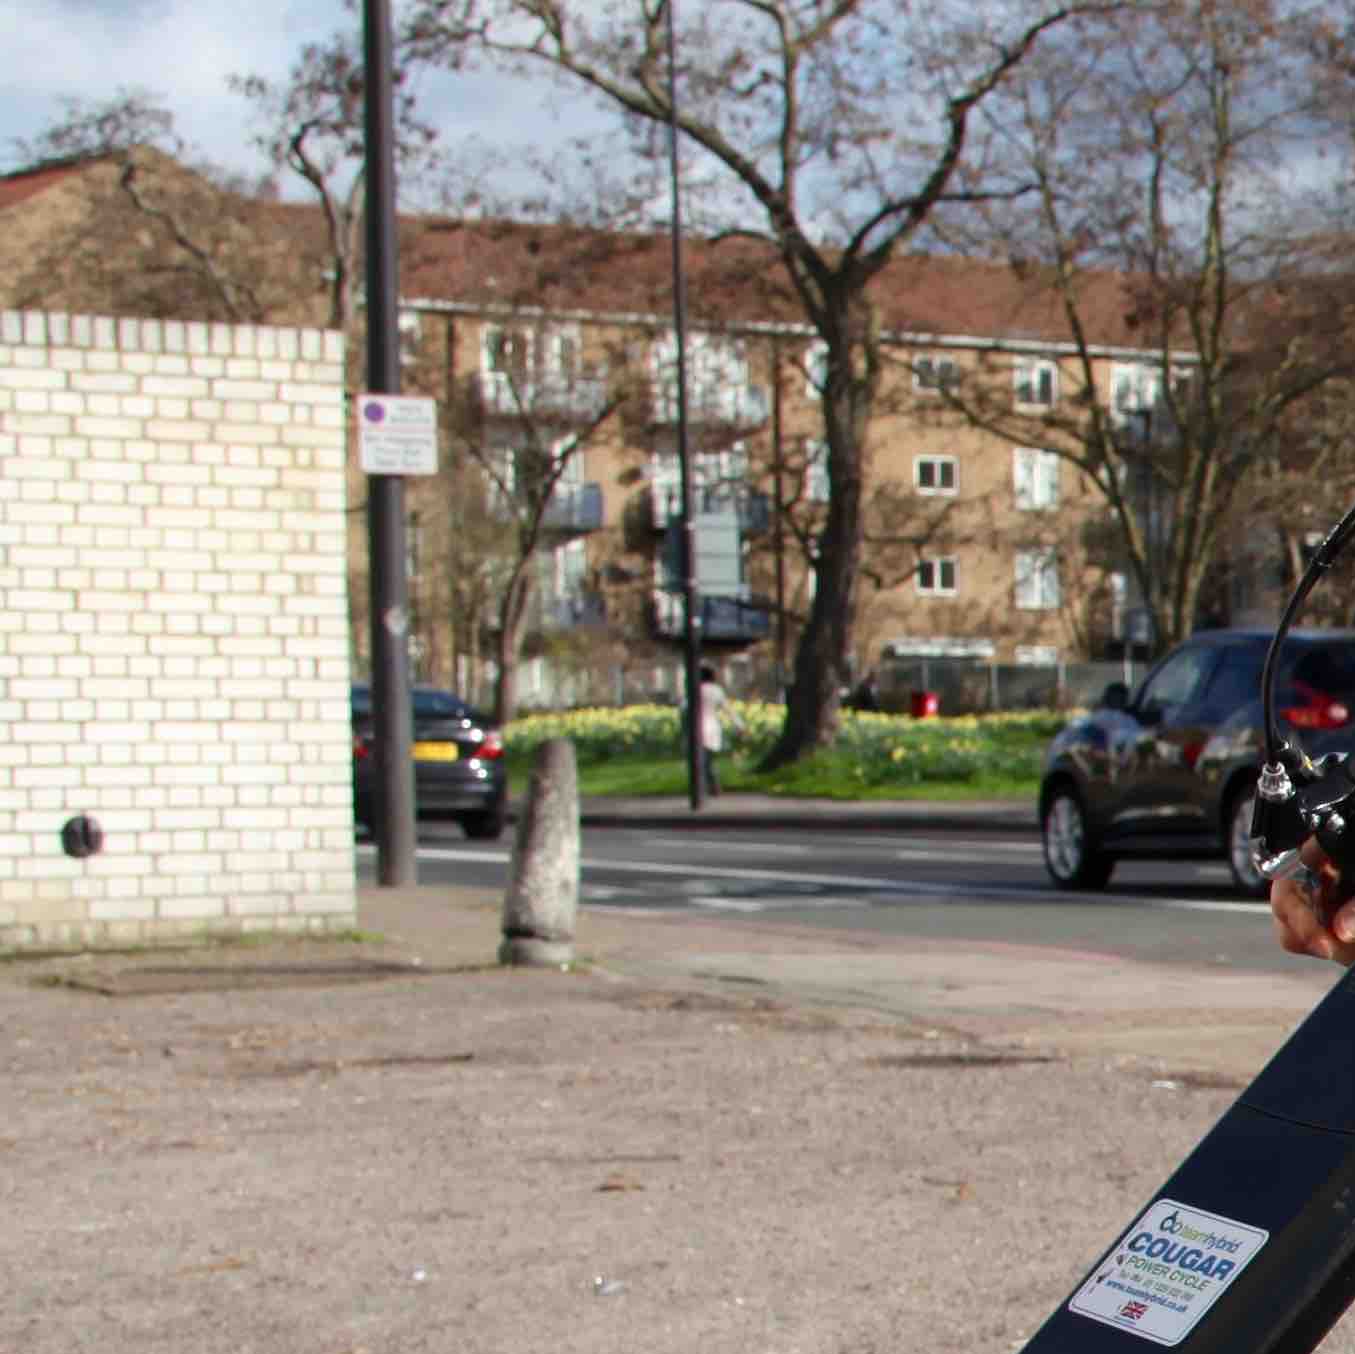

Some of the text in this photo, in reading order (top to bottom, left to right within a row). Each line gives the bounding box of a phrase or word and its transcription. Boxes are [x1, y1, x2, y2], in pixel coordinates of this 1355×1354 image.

[1126, 1255, 1169, 1277] POWER
[1169, 1270, 1211, 1291] CYCLE
[1128, 1232, 1236, 1281] COUGAR
